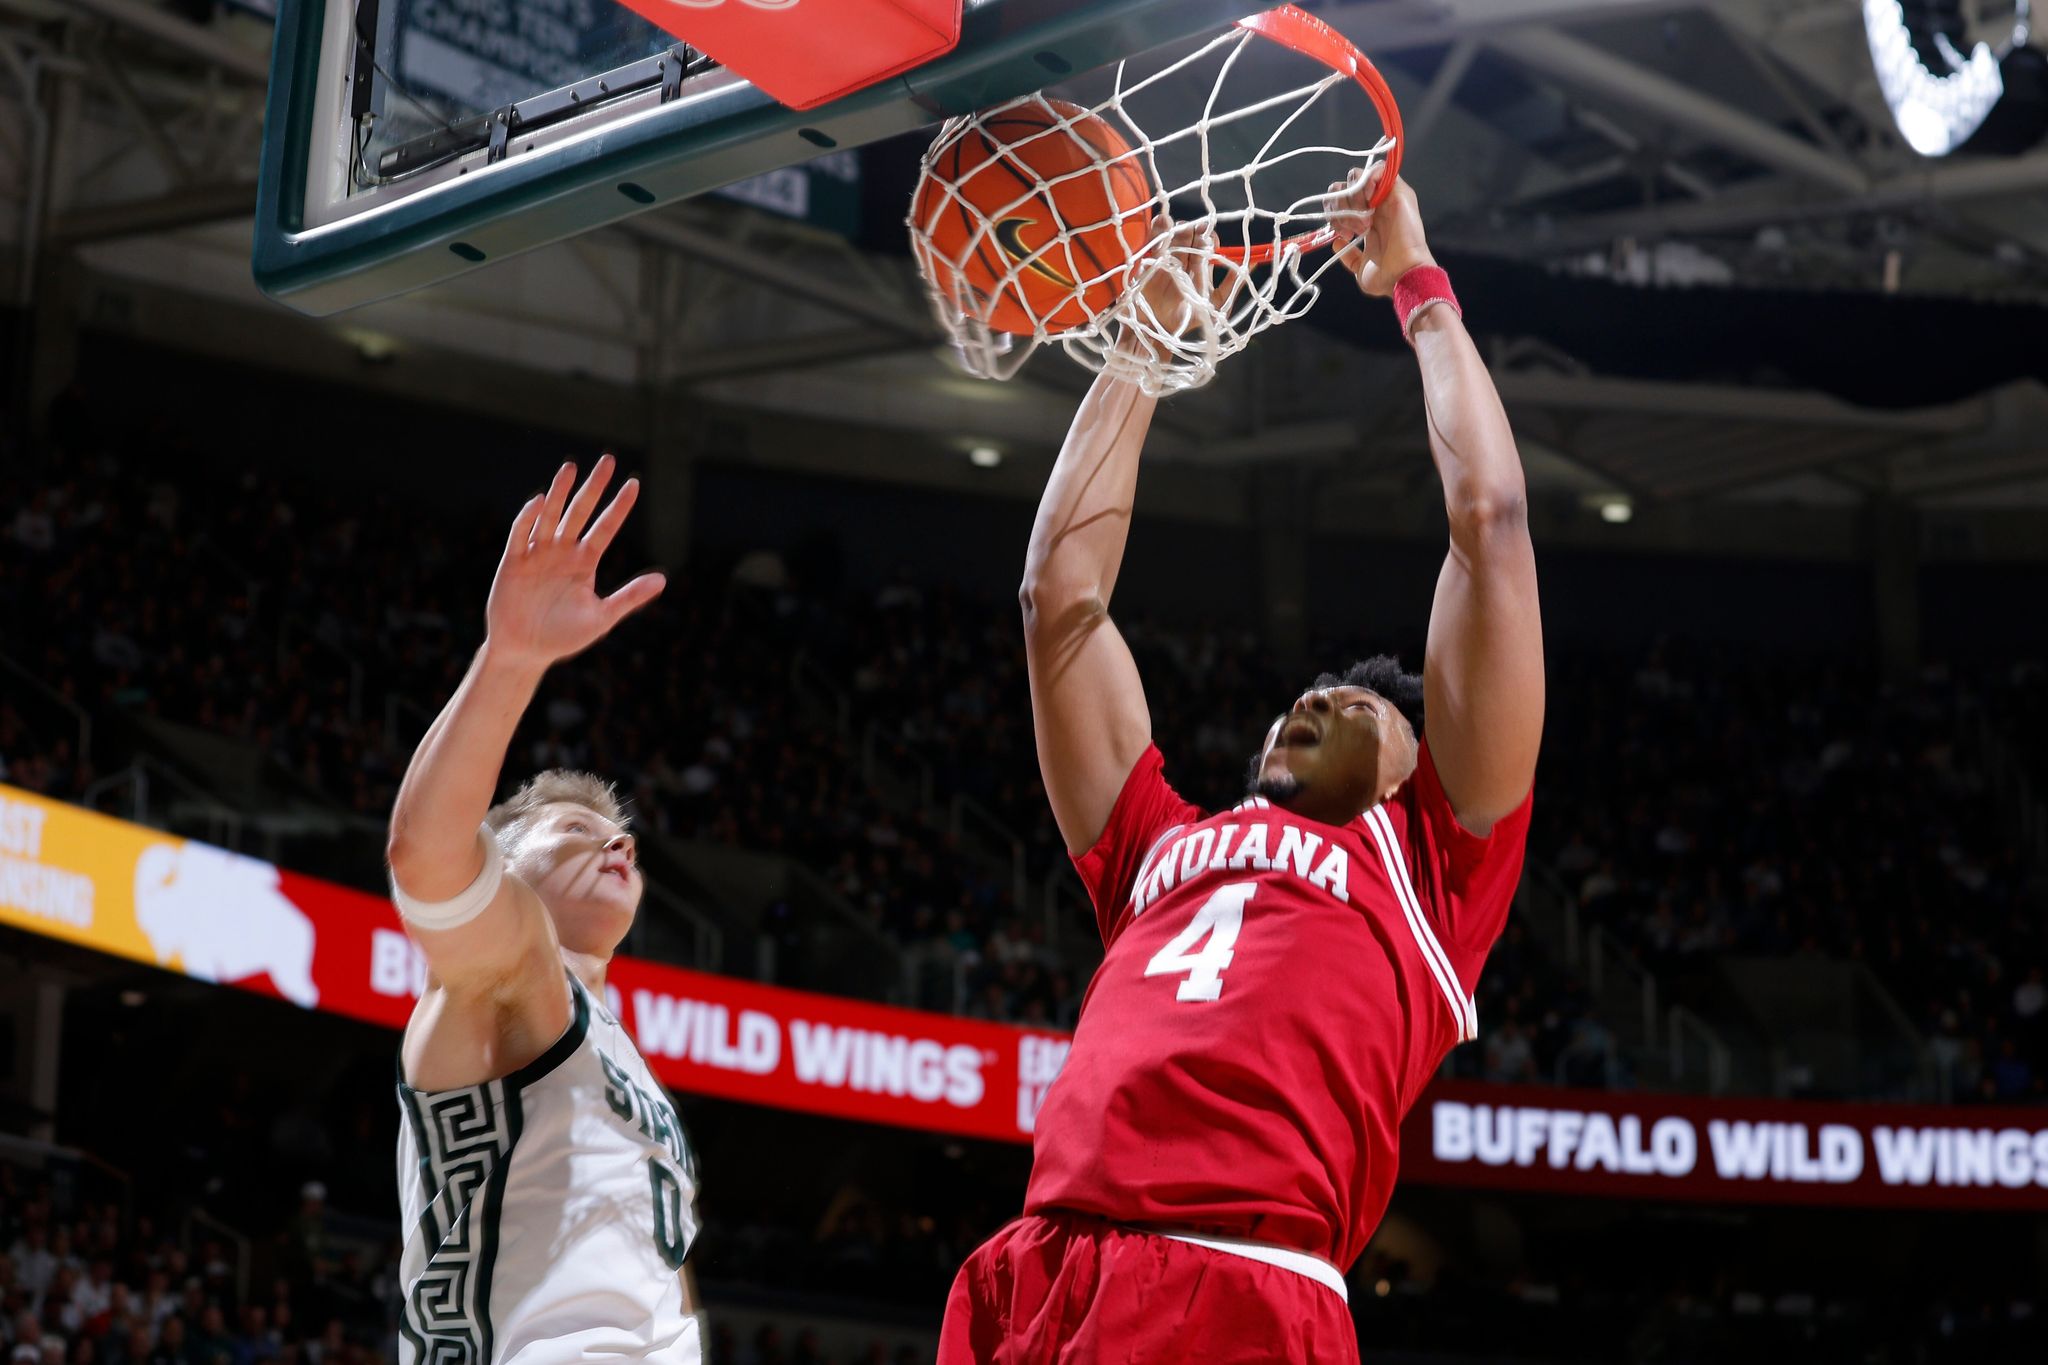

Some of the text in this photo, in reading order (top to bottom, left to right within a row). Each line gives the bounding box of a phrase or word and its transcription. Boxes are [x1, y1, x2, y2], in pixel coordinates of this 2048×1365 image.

[1135, 823, 1350, 917] INDIANA
[1144, 882, 1258, 1002] 4
[632, 988, 782, 1075] WILD
[788, 1018, 985, 1107] WINGS
[1432, 1101, 1698, 1176] BUFFALO
[1708, 1119, 1865, 1182] WILD
[649, 1156, 686, 1271] 0
